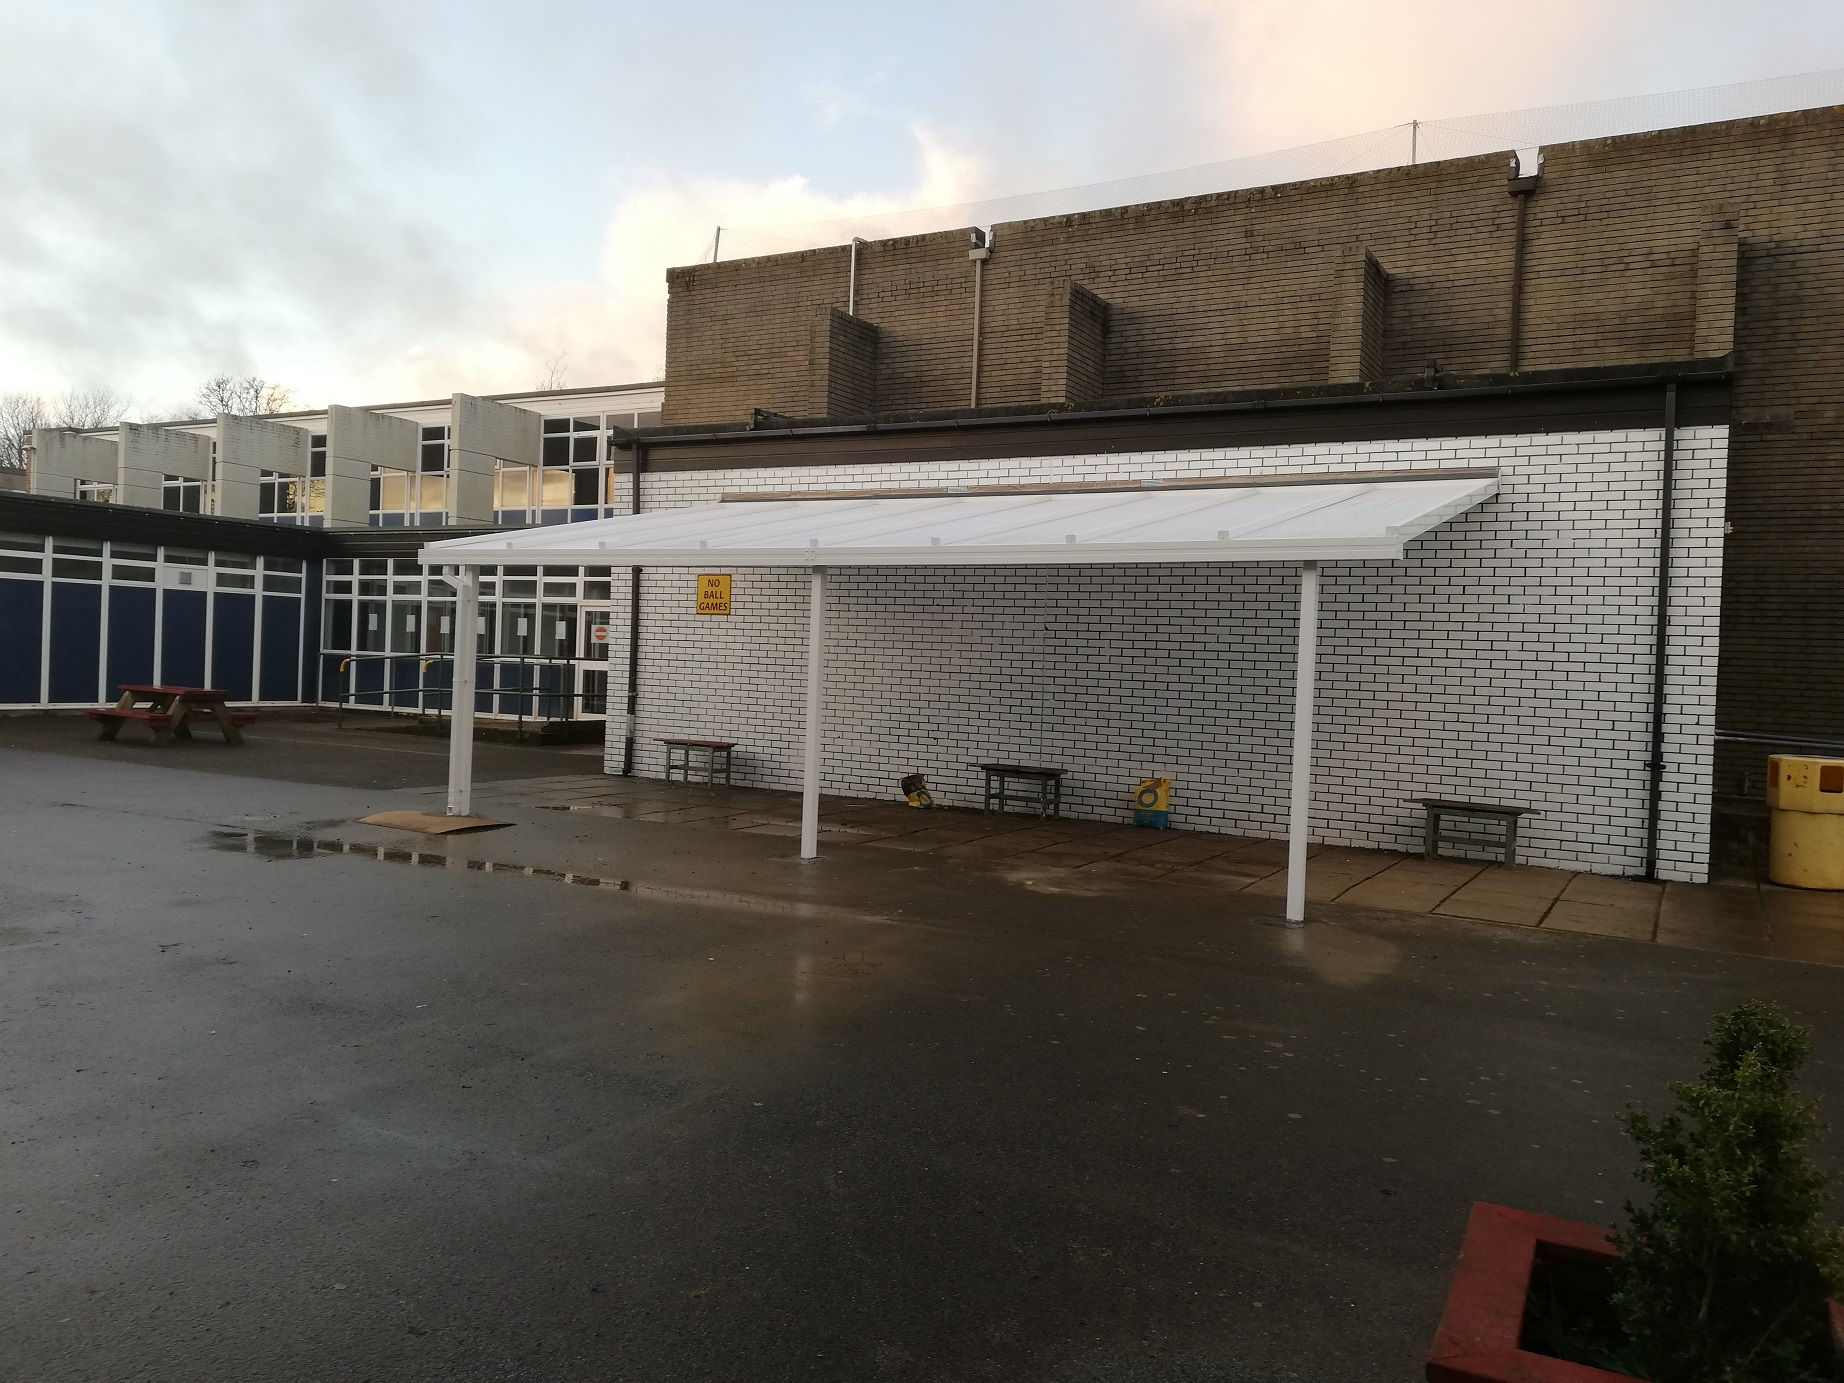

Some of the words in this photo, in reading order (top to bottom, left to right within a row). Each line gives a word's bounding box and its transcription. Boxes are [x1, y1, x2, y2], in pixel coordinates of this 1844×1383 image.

[708, 578, 720, 588] NO
[704, 590, 724, 599] BALL
[699, 602, 728, 610] GAMES
